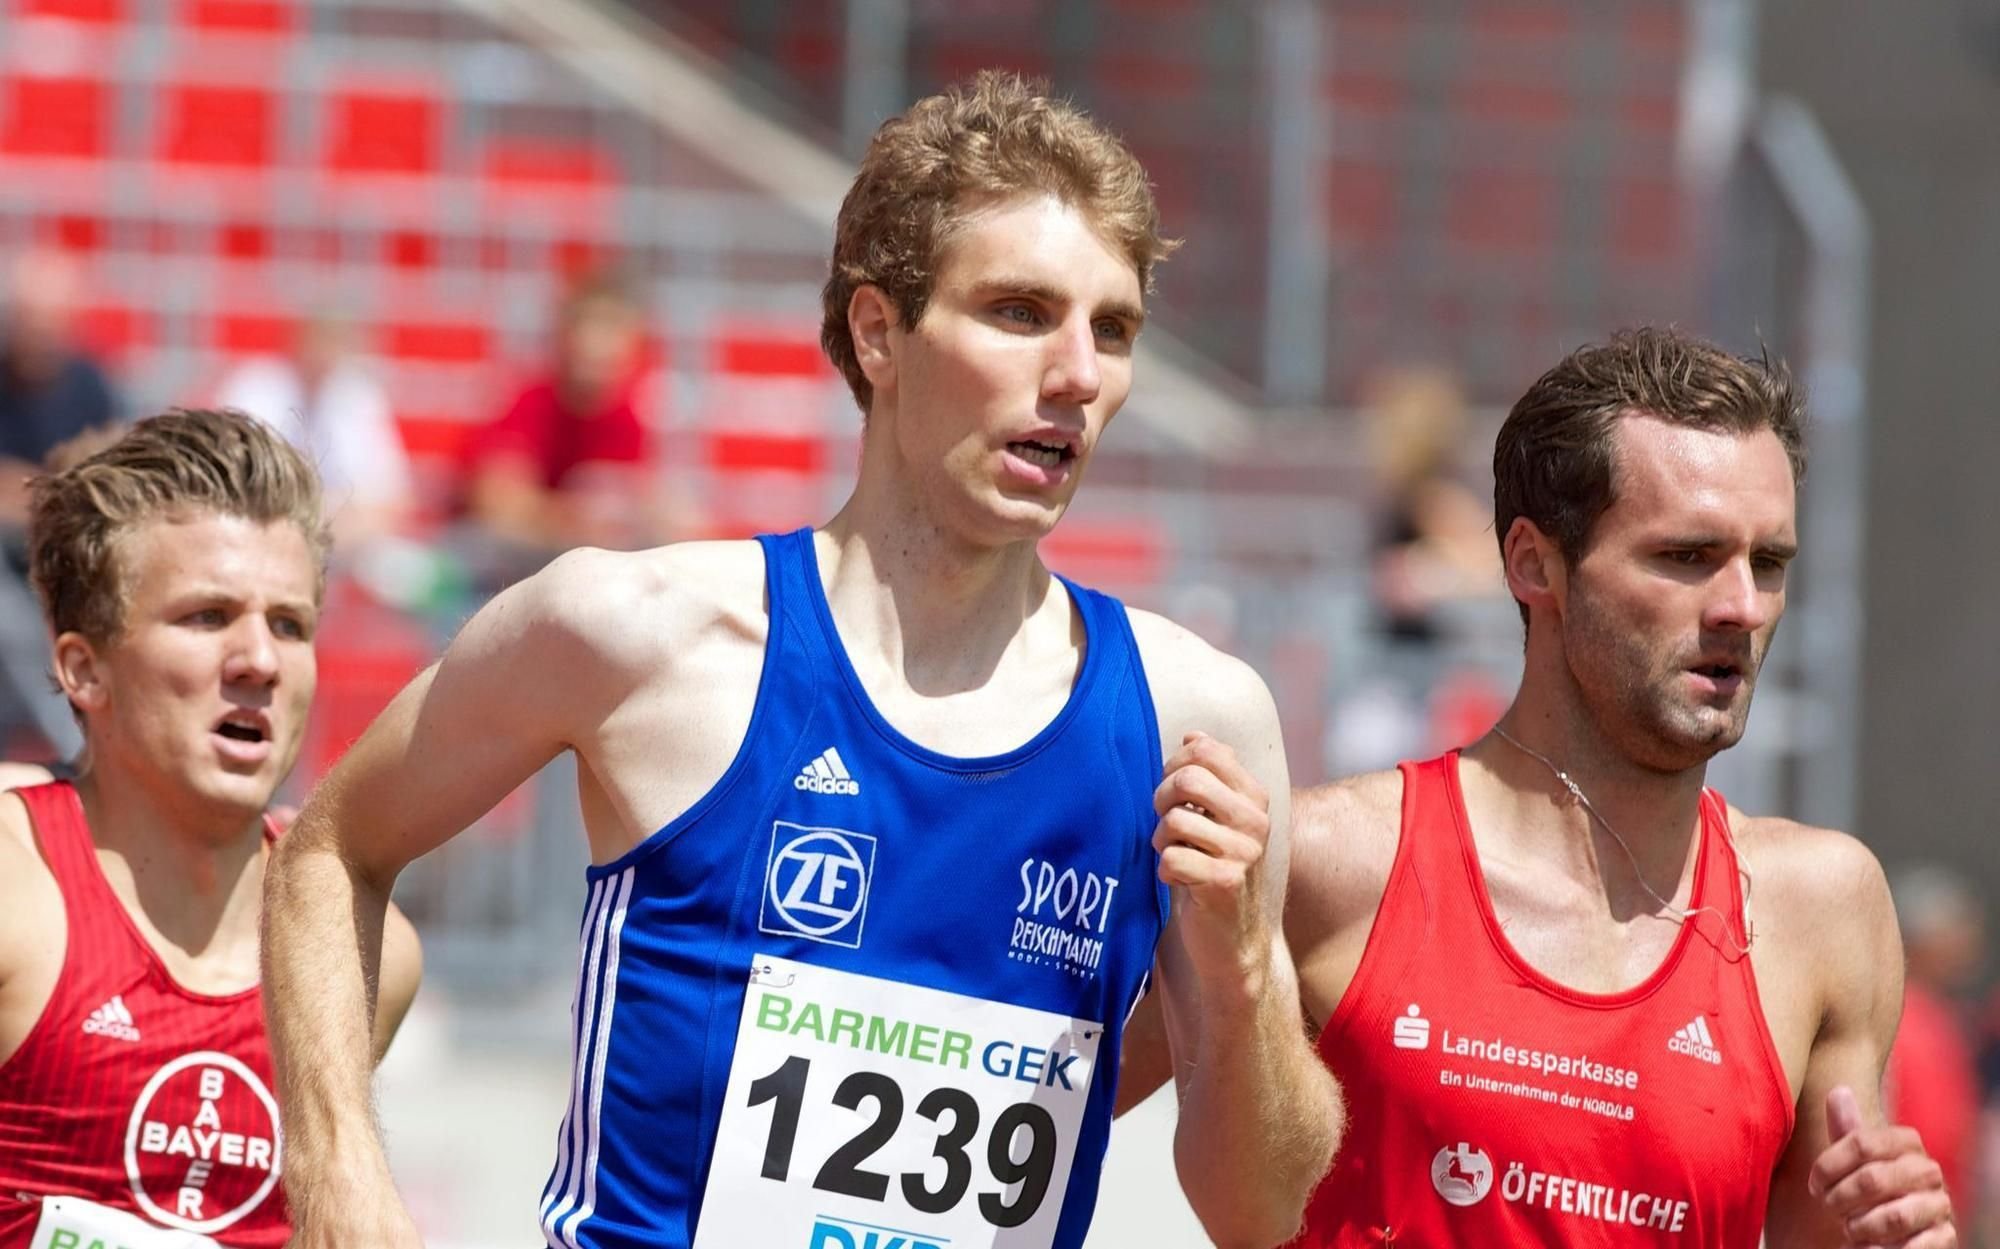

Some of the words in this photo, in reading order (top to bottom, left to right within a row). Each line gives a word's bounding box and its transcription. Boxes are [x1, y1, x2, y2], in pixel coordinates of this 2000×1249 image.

[793, 775, 860, 796] adidas
[781, 850, 861, 919] ZF
[1016, 858, 1119, 933] SPORT
[1010, 917, 1104, 969] REISCHMANN
[756, 993, 973, 1069] BARMER
[982, 1041, 1080, 1091] GEK
[1441, 1029, 1639, 1090] Landessparkasse
[1667, 1037, 1722, 1065] adidas
[1439, 1070, 1462, 1086] Ein
[1465, 1073, 1559, 1103] Unternehmen
[1560, 1091, 1582, 1109] der
[140, 1120, 273, 1170] BAYER
[746, 1055, 1058, 1228] 1239
[1501, 1161, 1690, 1233] ÖFFENTLICHE
